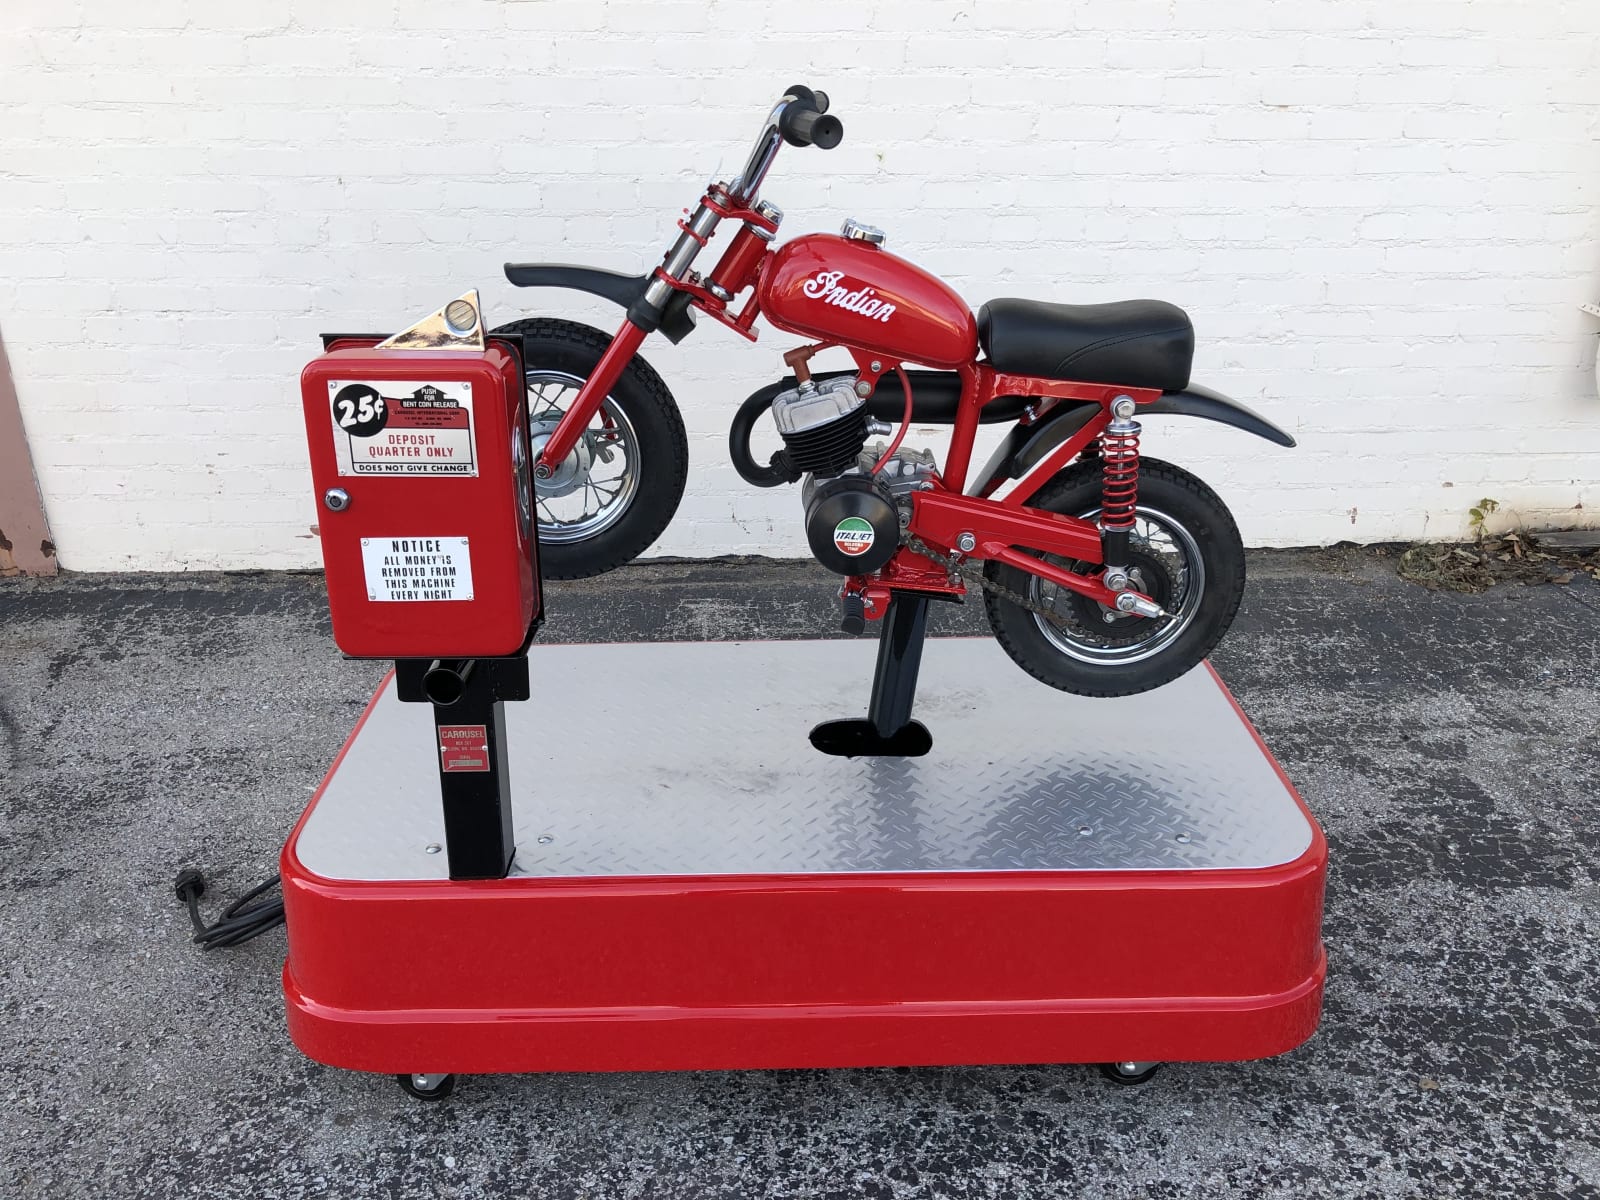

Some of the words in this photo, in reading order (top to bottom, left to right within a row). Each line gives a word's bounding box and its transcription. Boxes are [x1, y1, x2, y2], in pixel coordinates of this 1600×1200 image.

[803, 270, 896, 322] Indian
[338, 393, 384, 427] 25¢
[388, 434, 435, 445] DEPOSIT
[369, 446, 421, 458] QUARTER
[427, 447, 454, 458] ONLY
[407, 464, 428, 472] GIVE
[431, 464, 468, 472] CHANGE
[392, 540, 441, 553] NOTICE
[384, 556, 400, 566] ALL
[382, 567, 426, 577] REMOVED
[431, 567, 456, 576] FROM
[385, 579, 408, 589] THIS
[413, 578, 456, 588] MACHINE
[391, 590, 419, 600] EVERY
[424, 589, 453, 599] NIGHT
[441, 730, 485, 739] CAROUSEL
